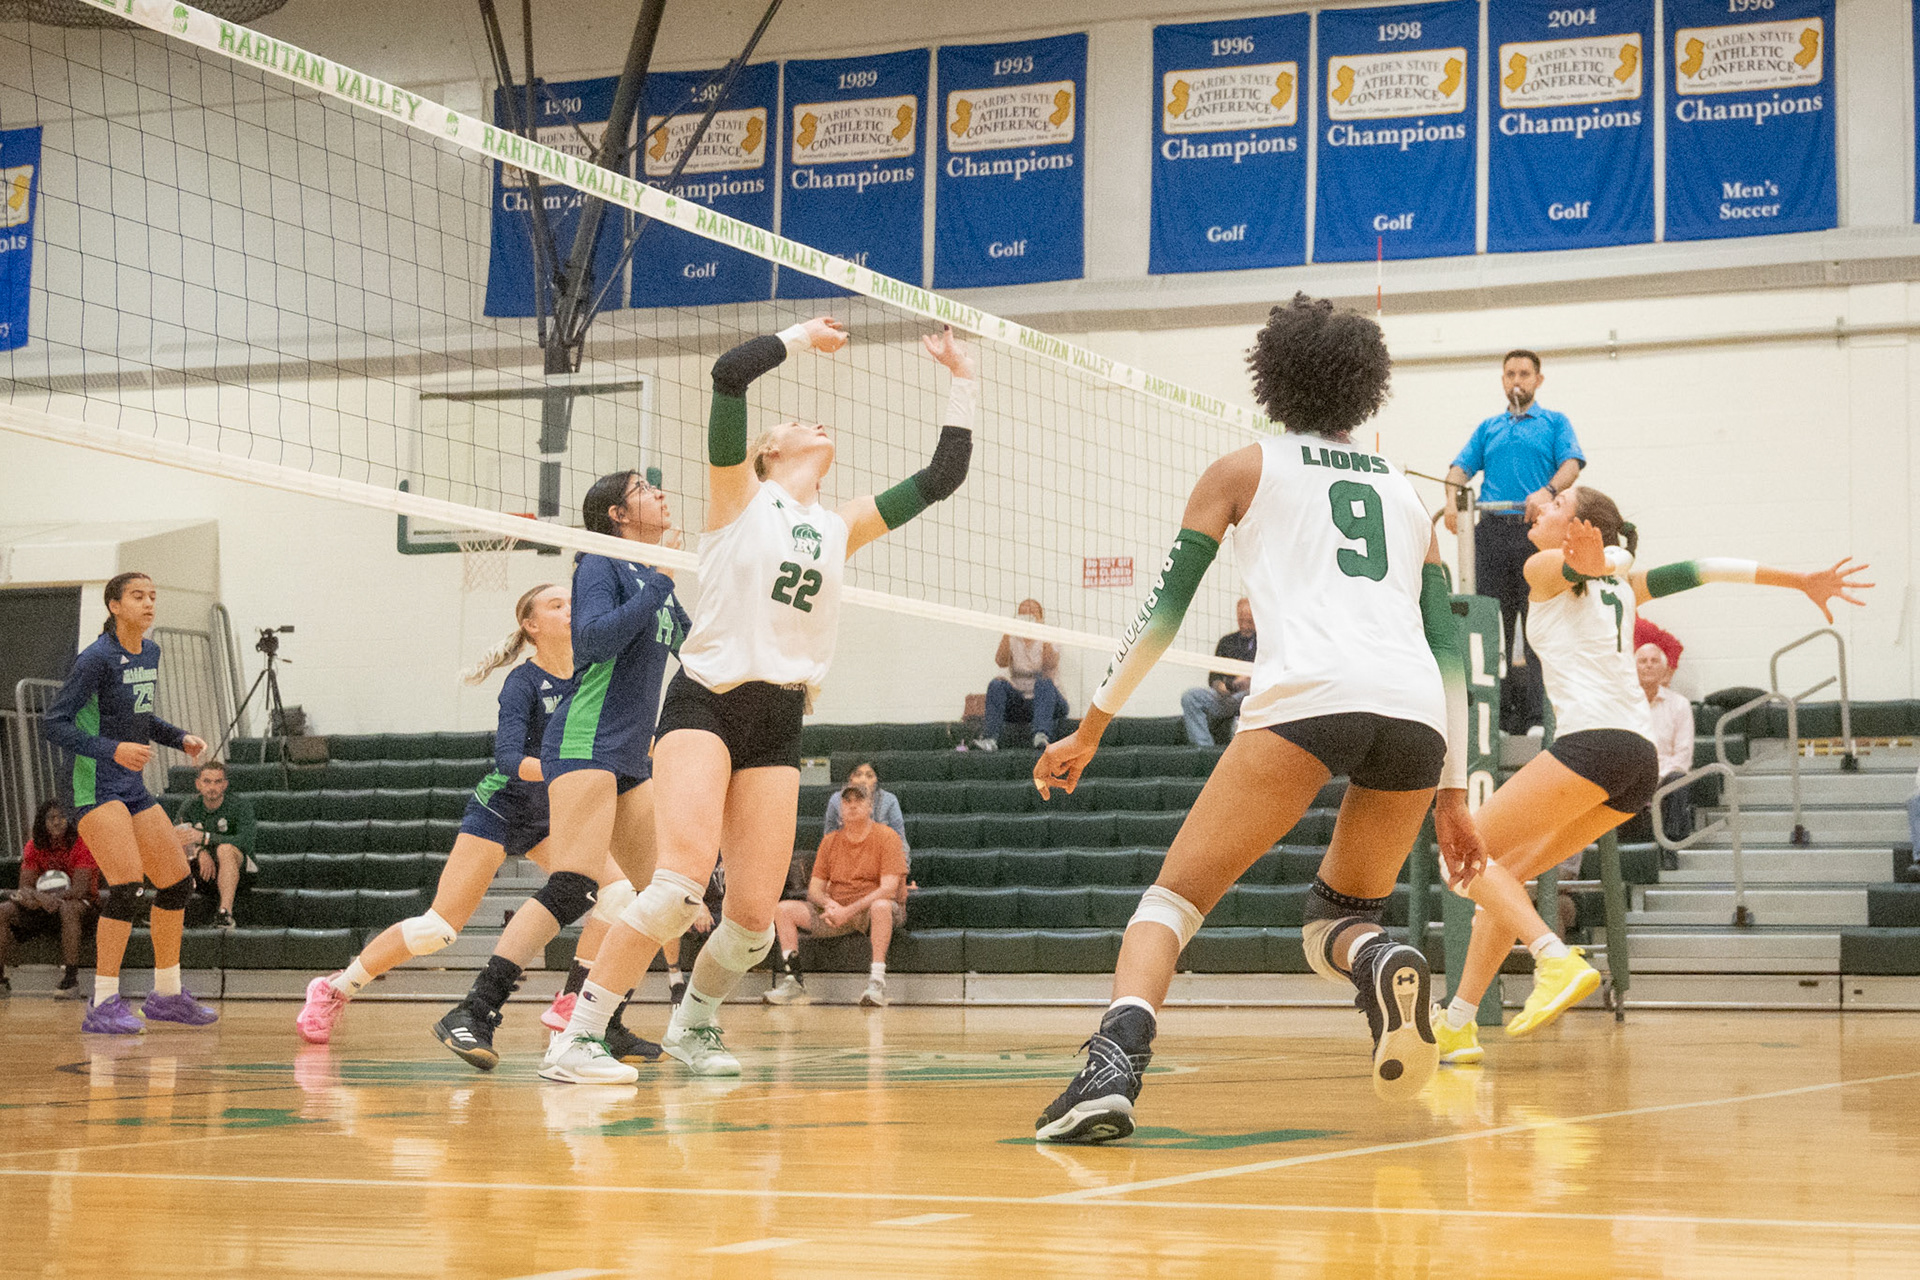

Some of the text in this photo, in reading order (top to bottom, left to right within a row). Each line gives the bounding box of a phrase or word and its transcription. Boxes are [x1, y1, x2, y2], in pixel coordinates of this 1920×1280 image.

[1548, 8, 1597, 28] 2004
[1378, 22, 1422, 41] 1998
[1706, 32, 1795, 50] GARDEN STATE
[1211, 36, 1254, 56] 1996
[1528, 46, 1617, 65] GARDEN STATE
[1712, 46, 1784, 64] ATHLETIC
[219, 23, 423, 121] RARITAN VALLEY
[993, 56, 1034, 76] 1993
[1357, 60, 1441, 77] GARDEN STATE
[1535, 61, 1604, 78] ATHLETIC
[1698, 60, 1796, 81] CONFERENCE
[838, 70, 878, 90] 1989
[1191, 74, 1272, 92] GARDEN STATE
[1362, 74, 1429, 90] ATHLETIC
[1521, 75, 1616, 95] CONFERENCE
[974, 93, 1051, 111] GARDEN STATE
[1196, 87, 1261, 105] ATHLETIC
[1348, 87, 1440, 106] CONFERENCE
[820, 107, 893, 124] GARDEN STATE
[979, 106, 1041, 123] ATHLETIC
[1184, 101, 1272, 120] CONFERENCE
[1675, 93, 1823, 125] Champions
[824, 120, 883, 136] ATHLETIC
[967, 120, 1051, 139] CONFERENCE
[1499, 107, 1642, 139] Champions
[811, 133, 894, 151] CONFERENCE
[1327, 120, 1466, 151] Champions
[1161, 133, 1297, 164] Champions
[482, 126, 647, 208] RARITAN VALLEY
[947, 150, 1073, 180] Champions
[791, 164, 915, 193] Champions
[1722, 180, 1779, 199] Men's
[1548, 201, 1592, 221] Golf
[1720, 203, 1780, 219] Soccer
[1373, 212, 1414, 231] Golf
[696, 207, 830, 275] RARITAN VALLEY
[1207, 224, 1247, 242] Golf
[988, 240, 1028, 258] Golf
[683, 262, 718, 279] Golf
[871, 273, 983, 330] RARITAN VALLEY
[1019, 328, 1114, 378] RARITAN VALLEY
[1144, 374, 1226, 418] RARITAN VALLEY
[1301, 445, 1389, 474] LIONS
[1329, 480, 1389, 582] 9
[771, 561, 823, 613] 22
